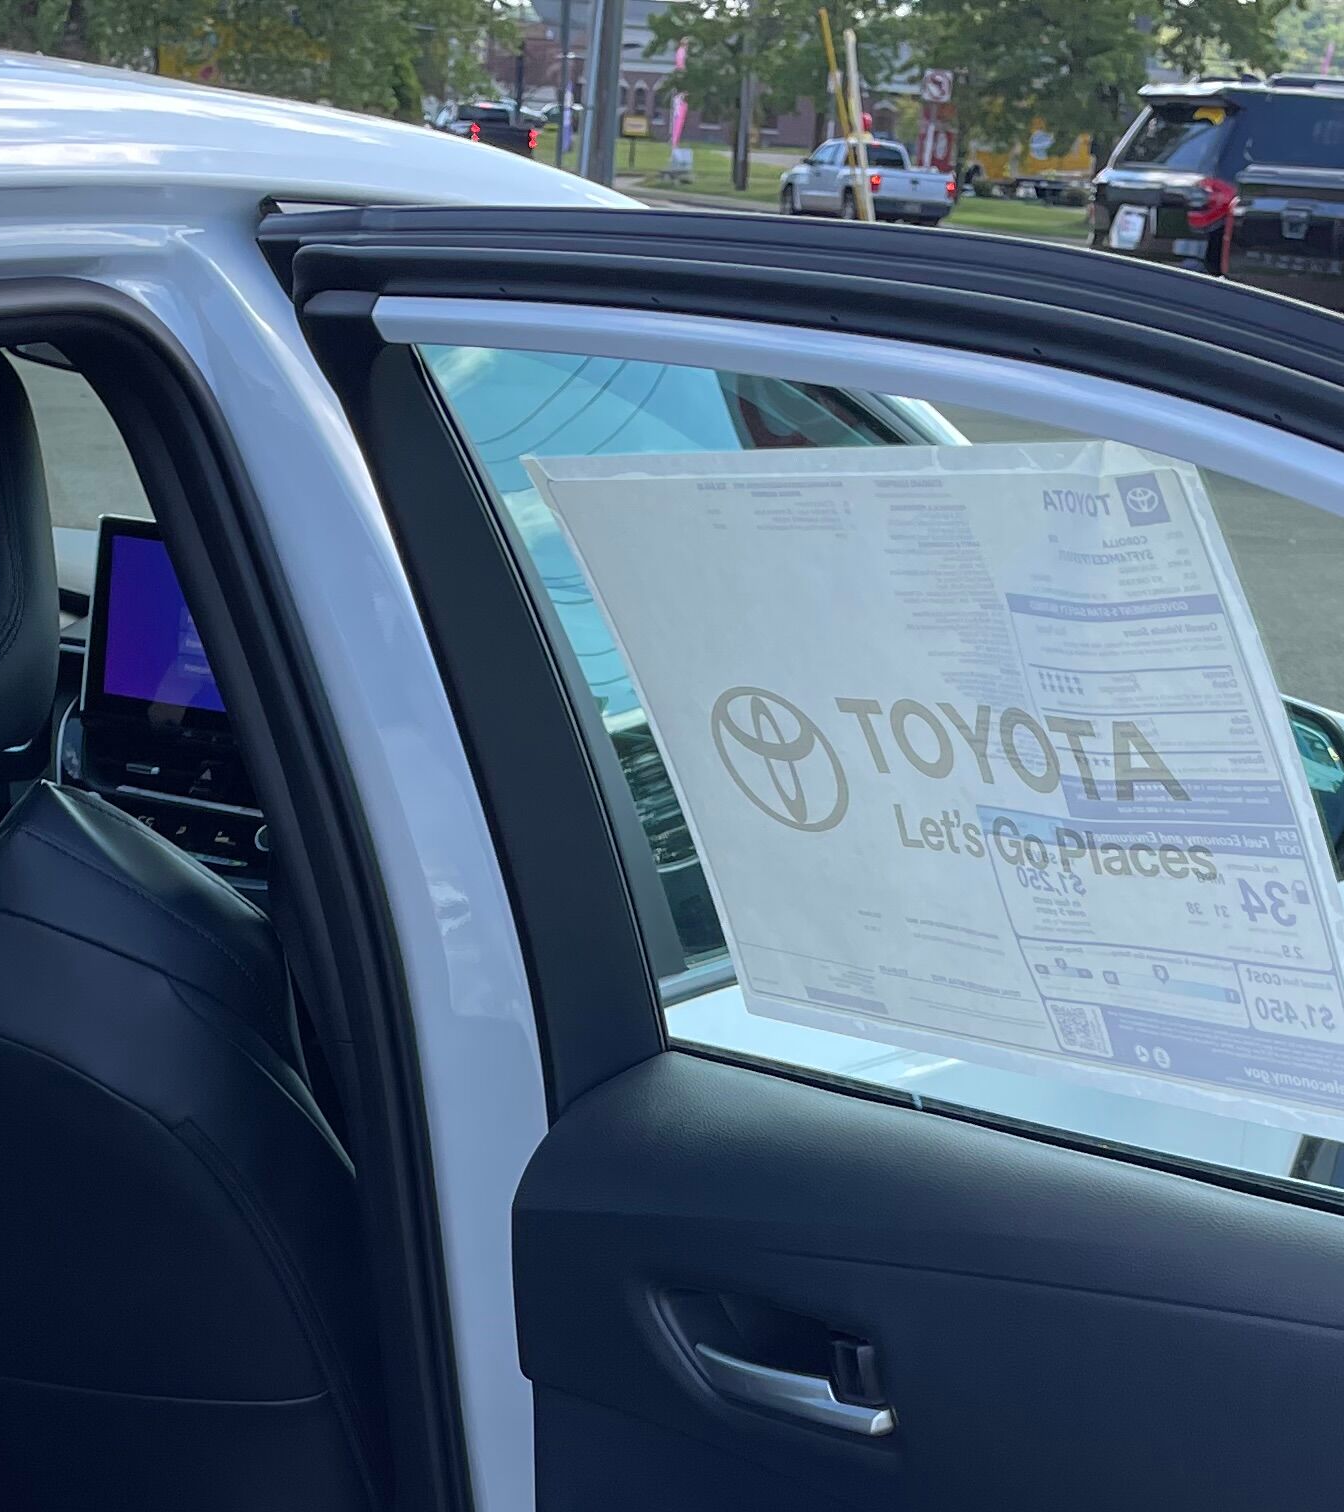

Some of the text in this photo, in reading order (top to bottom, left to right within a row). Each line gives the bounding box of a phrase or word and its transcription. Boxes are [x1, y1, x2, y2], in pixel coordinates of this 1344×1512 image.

[835, 696, 1192, 801] TOYOTA
[894, 804, 1215, 879] Let's Go Places
